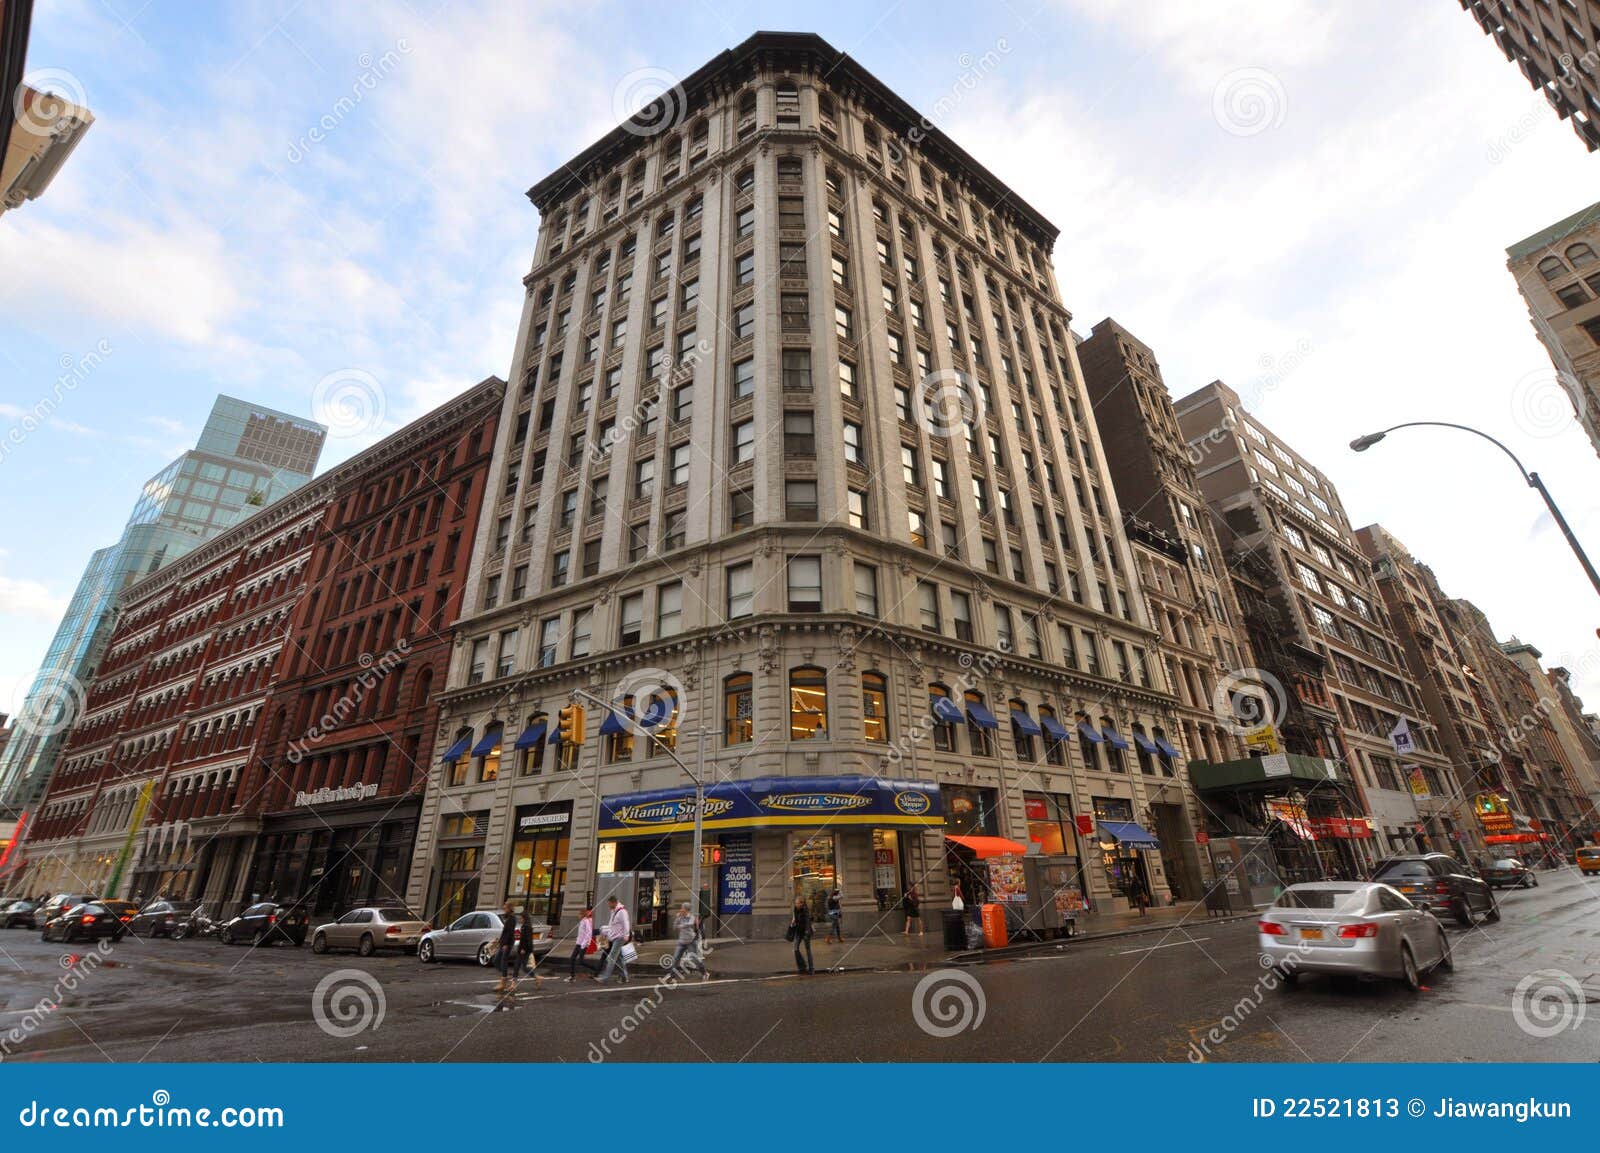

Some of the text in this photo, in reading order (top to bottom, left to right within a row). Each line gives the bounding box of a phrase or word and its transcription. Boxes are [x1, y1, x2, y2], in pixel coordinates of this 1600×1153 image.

[768, 795, 819, 805] Vitamin
[823, 796, 872, 807] Shoppe
[621, 804, 673, 819] Vitamin
[676, 800, 734, 815] Shppe
[729, 866, 746, 874] OVER
[725, 873, 751, 882] 20,000
[728, 881, 747, 889] ITEMS
[729, 890, 746, 898] 400
[724, 898, 751, 906] BRANDS
